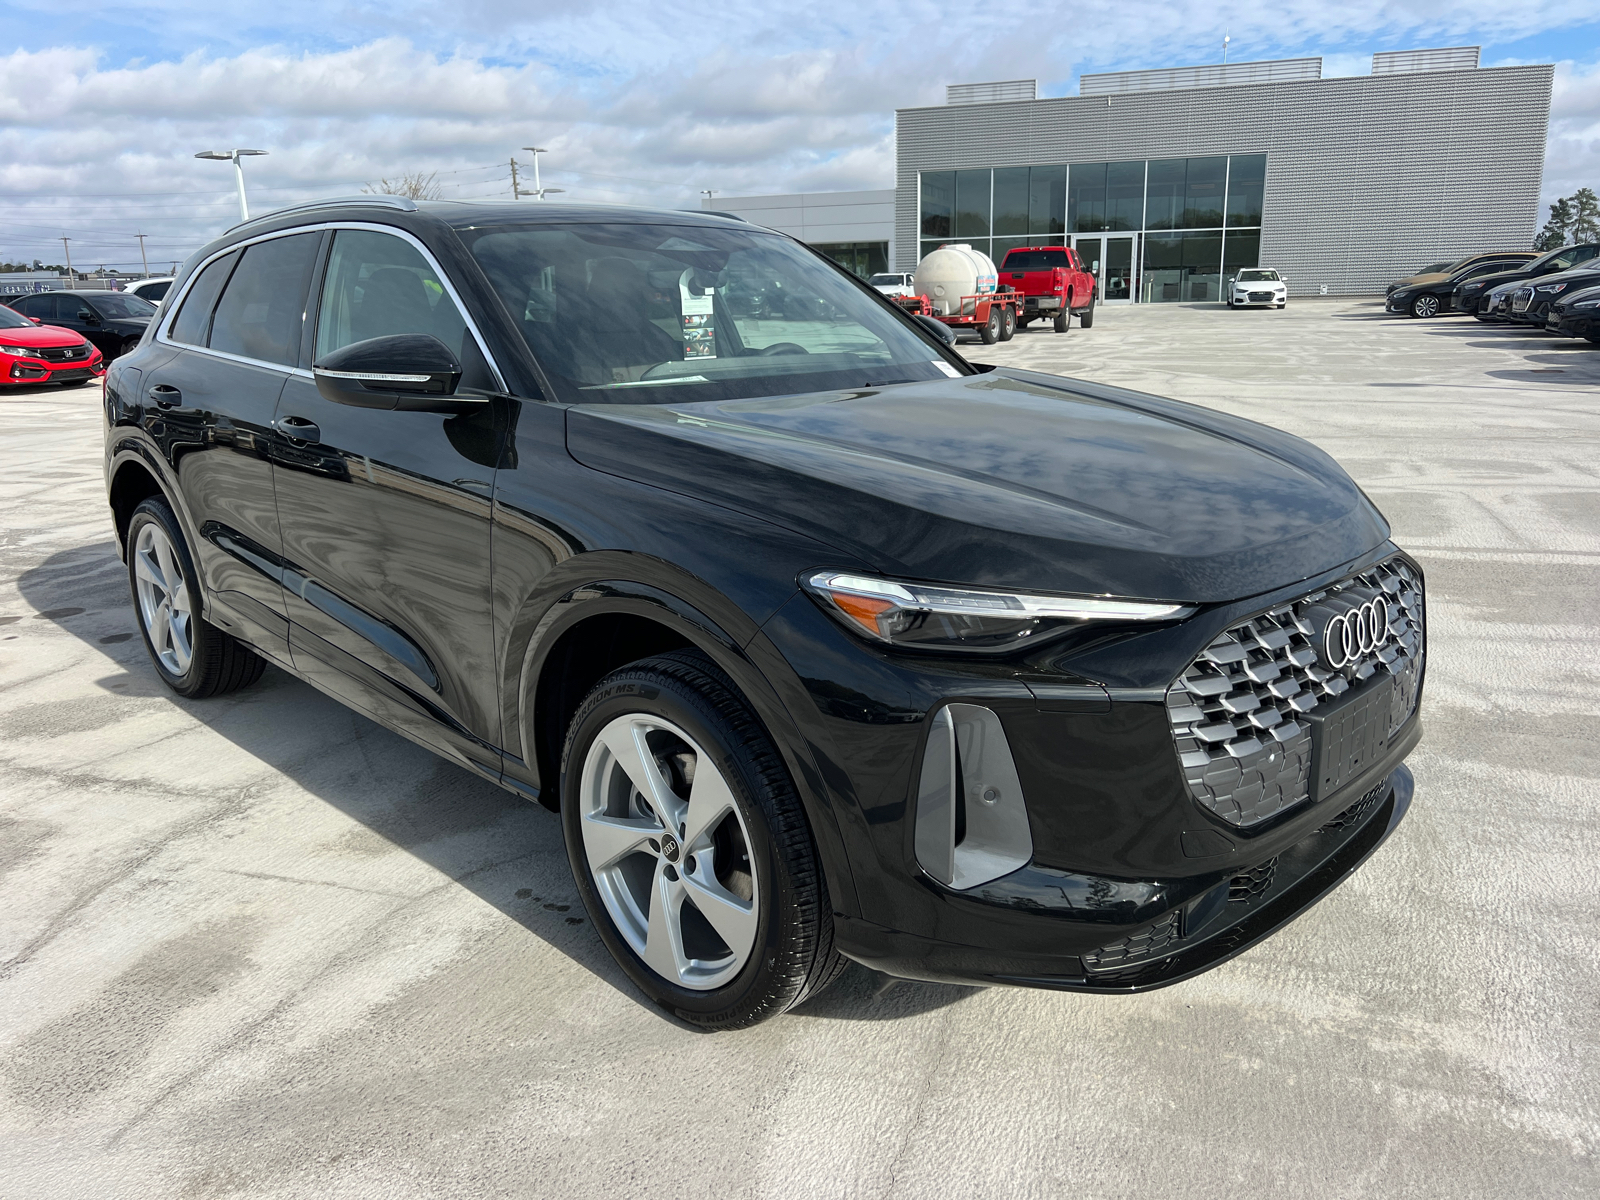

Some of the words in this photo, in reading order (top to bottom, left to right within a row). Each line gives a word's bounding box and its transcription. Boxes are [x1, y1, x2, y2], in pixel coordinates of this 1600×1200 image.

[615, 683, 636, 694] MS
[723, 753, 757, 808] PIRELLI
[706, 984, 761, 1023] CORPION
